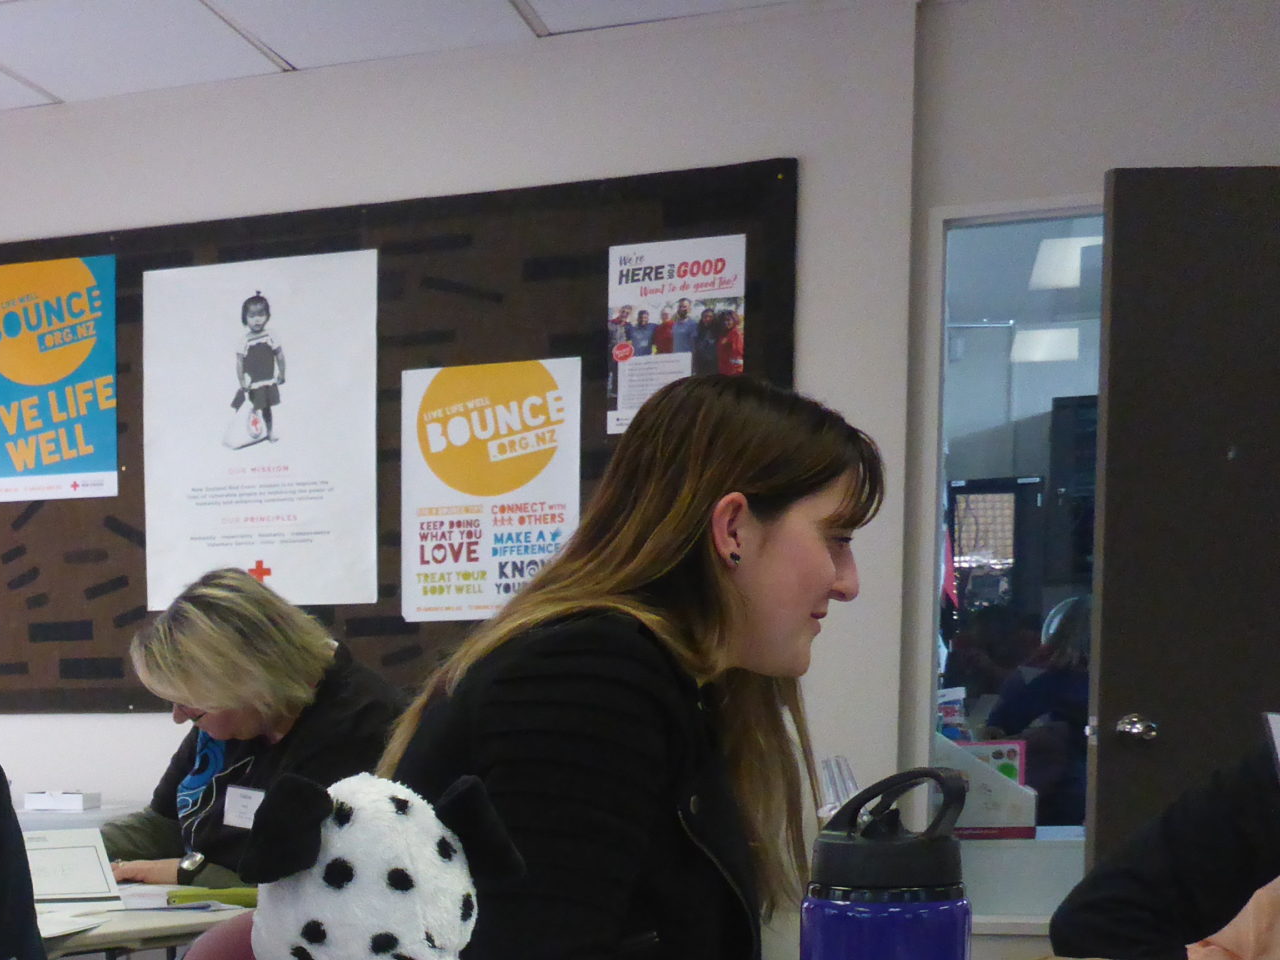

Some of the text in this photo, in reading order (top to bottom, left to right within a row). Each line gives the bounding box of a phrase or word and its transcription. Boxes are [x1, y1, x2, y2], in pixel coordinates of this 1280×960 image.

[619, 265, 665, 285] HERE
[676, 258, 726, 278] GOOD
[48, 375, 116, 423] LIFE
[426, 389, 566, 453] BOUNCE
[5, 424, 94, 472] WELL
[491, 502, 546, 514] CONNECT
[419, 519, 480, 531] KEEP DOING
[518, 513, 565, 526] OTHERS
[419, 529, 482, 542] WHAT YOU
[494, 530, 546, 545] MAKE A
[420, 541, 479, 566] LOVE
[491, 542, 561, 557] DIFFERENCE
[416, 570, 487, 583] TREAT YOUR
[422, 584, 483, 596] BODY WELL
